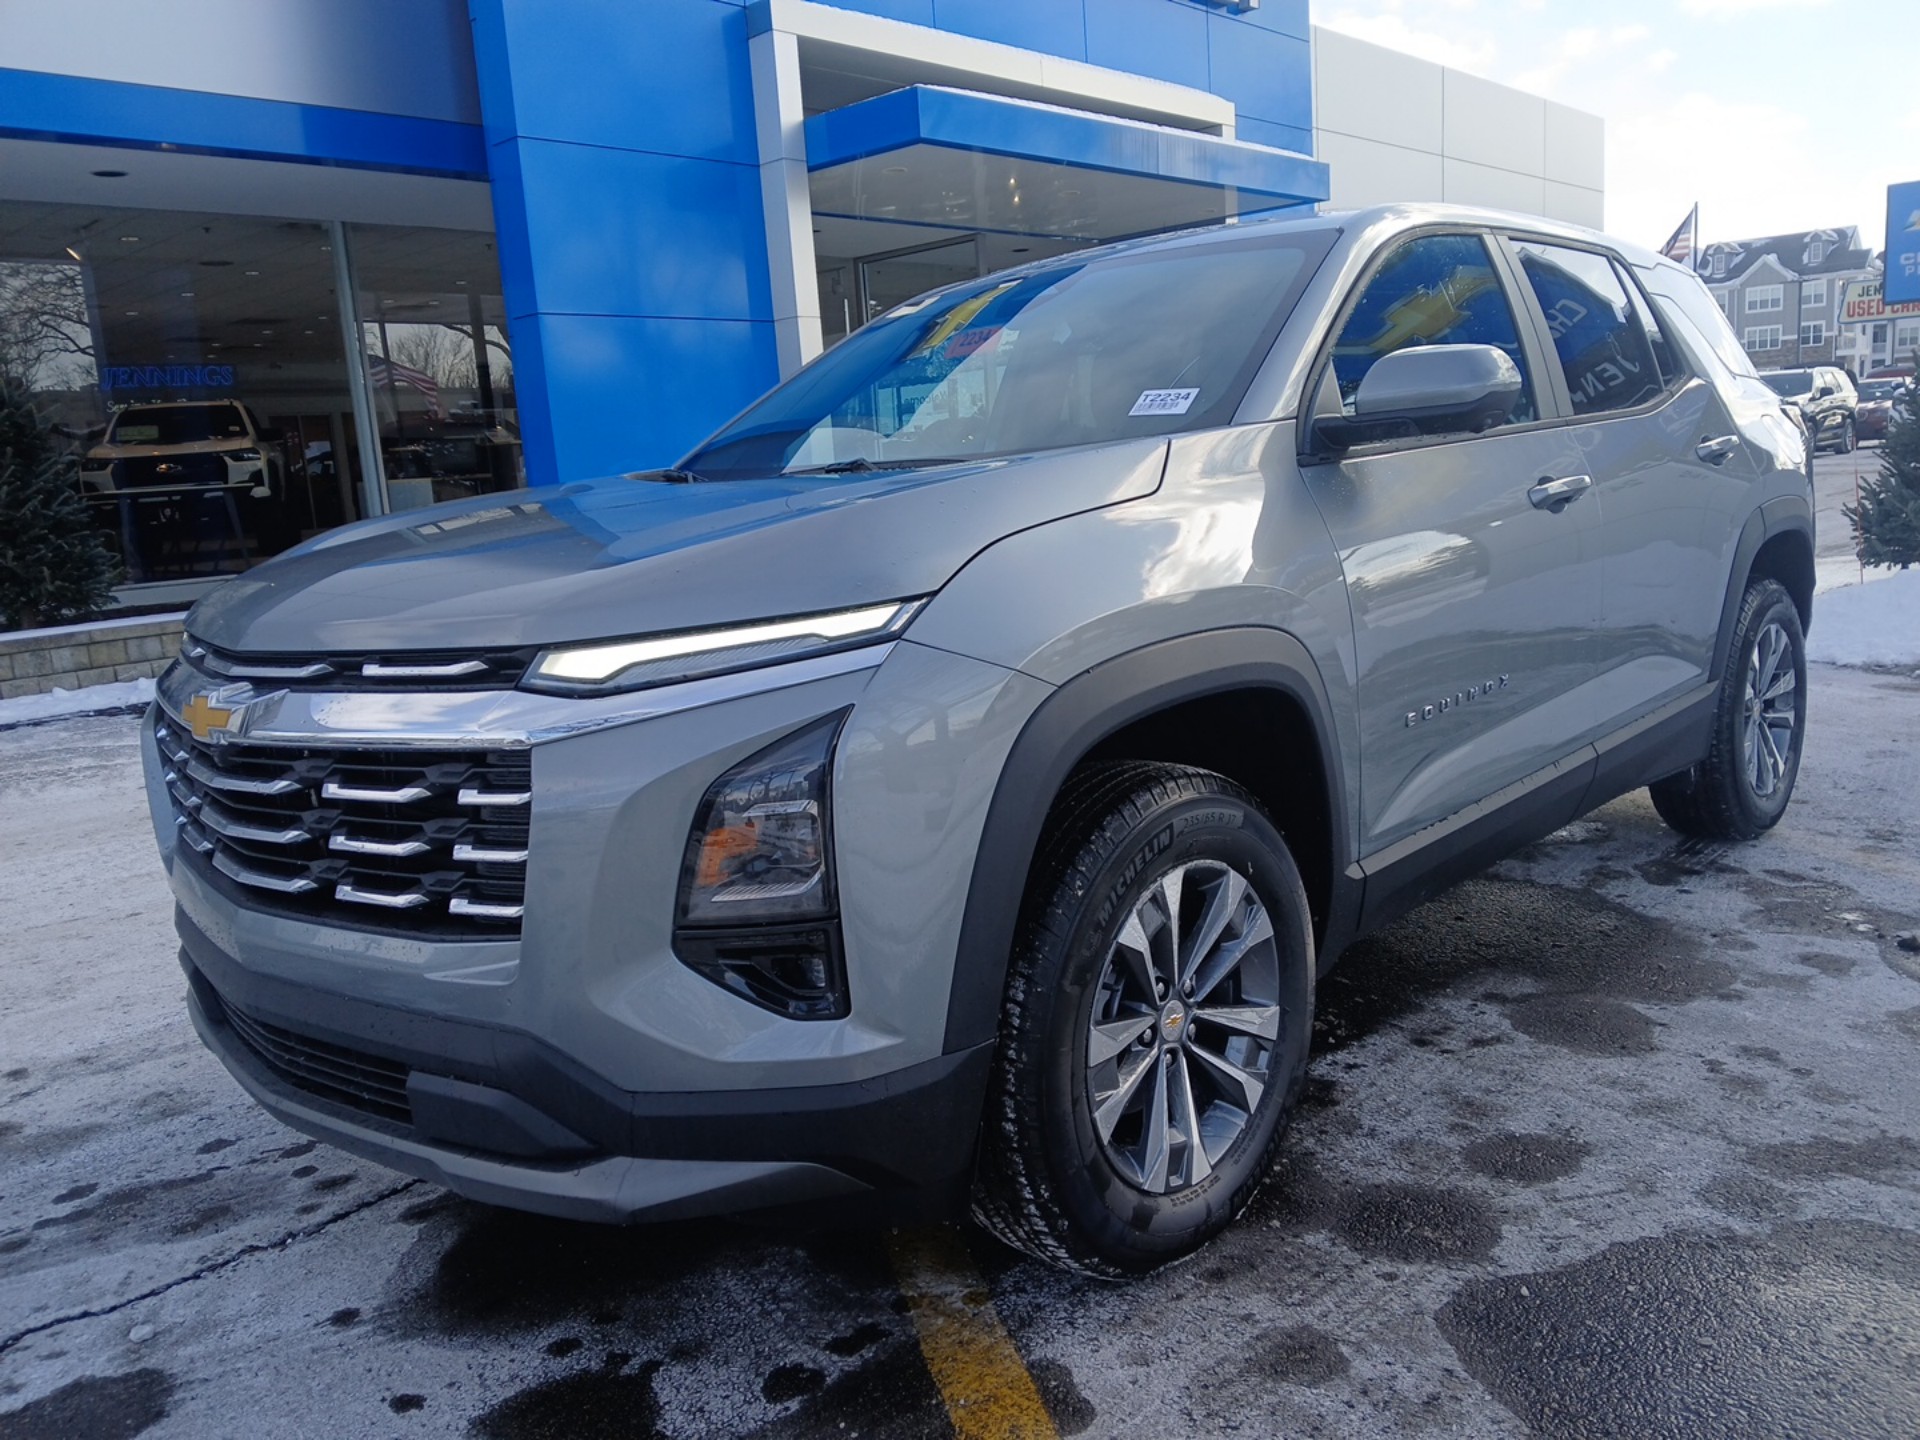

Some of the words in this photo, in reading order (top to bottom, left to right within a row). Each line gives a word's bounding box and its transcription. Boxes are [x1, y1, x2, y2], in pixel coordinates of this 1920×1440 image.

[1846, 298, 1885, 318] USED
[101, 365, 234, 391] JENNINGS
[1142, 391, 1192, 403] T2234
[1405, 673, 1509, 728] EQUINOX
[1098, 827, 1172, 928] MICHELIN
